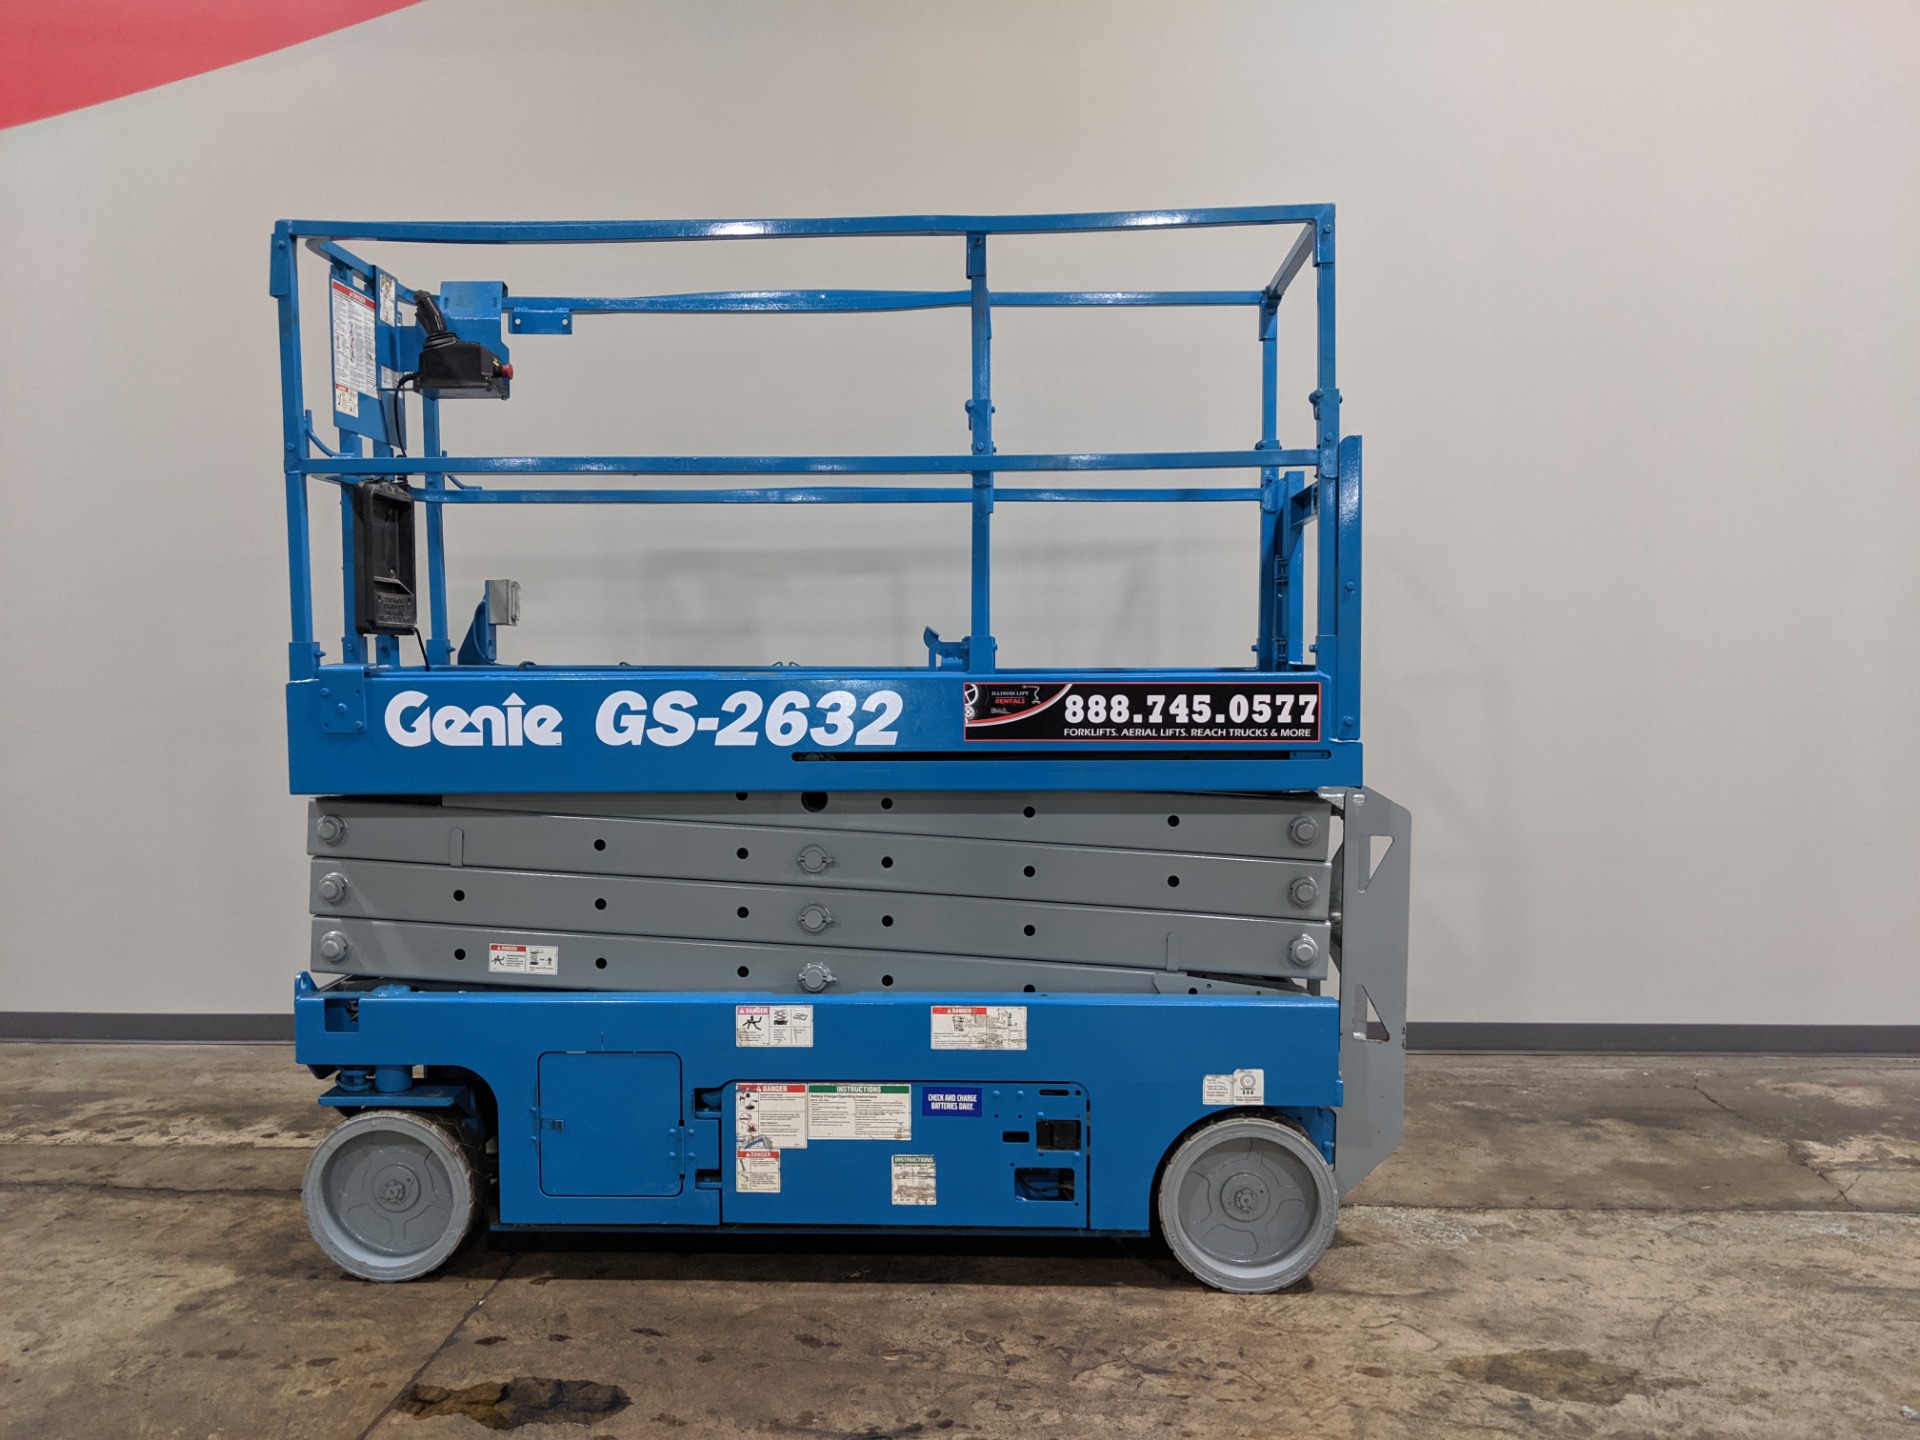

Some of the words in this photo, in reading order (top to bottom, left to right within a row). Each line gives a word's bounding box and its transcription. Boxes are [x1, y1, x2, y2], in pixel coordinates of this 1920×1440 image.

[1064, 694, 1318, 723] 888.745.0577
[385, 690, 563, 747] Genie
[595, 690, 904, 747] GS-2632
[1121, 728, 1158, 737] AERIAL
[1190, 728, 1226, 737] REACH
[1228, 728, 1268, 737] TRUCKS
[1270, 728, 1278, 737] &
[1280, 728, 1311, 737] MORE
[836, 1085, 882, 1093] INSTRUCTIONS
[928, 1093, 944, 1101] CHECK
[945, 1093, 956, 1101] AND
[957, 1094, 977, 1102] CHARGE
[931, 1102, 957, 1110] BATTERIES
